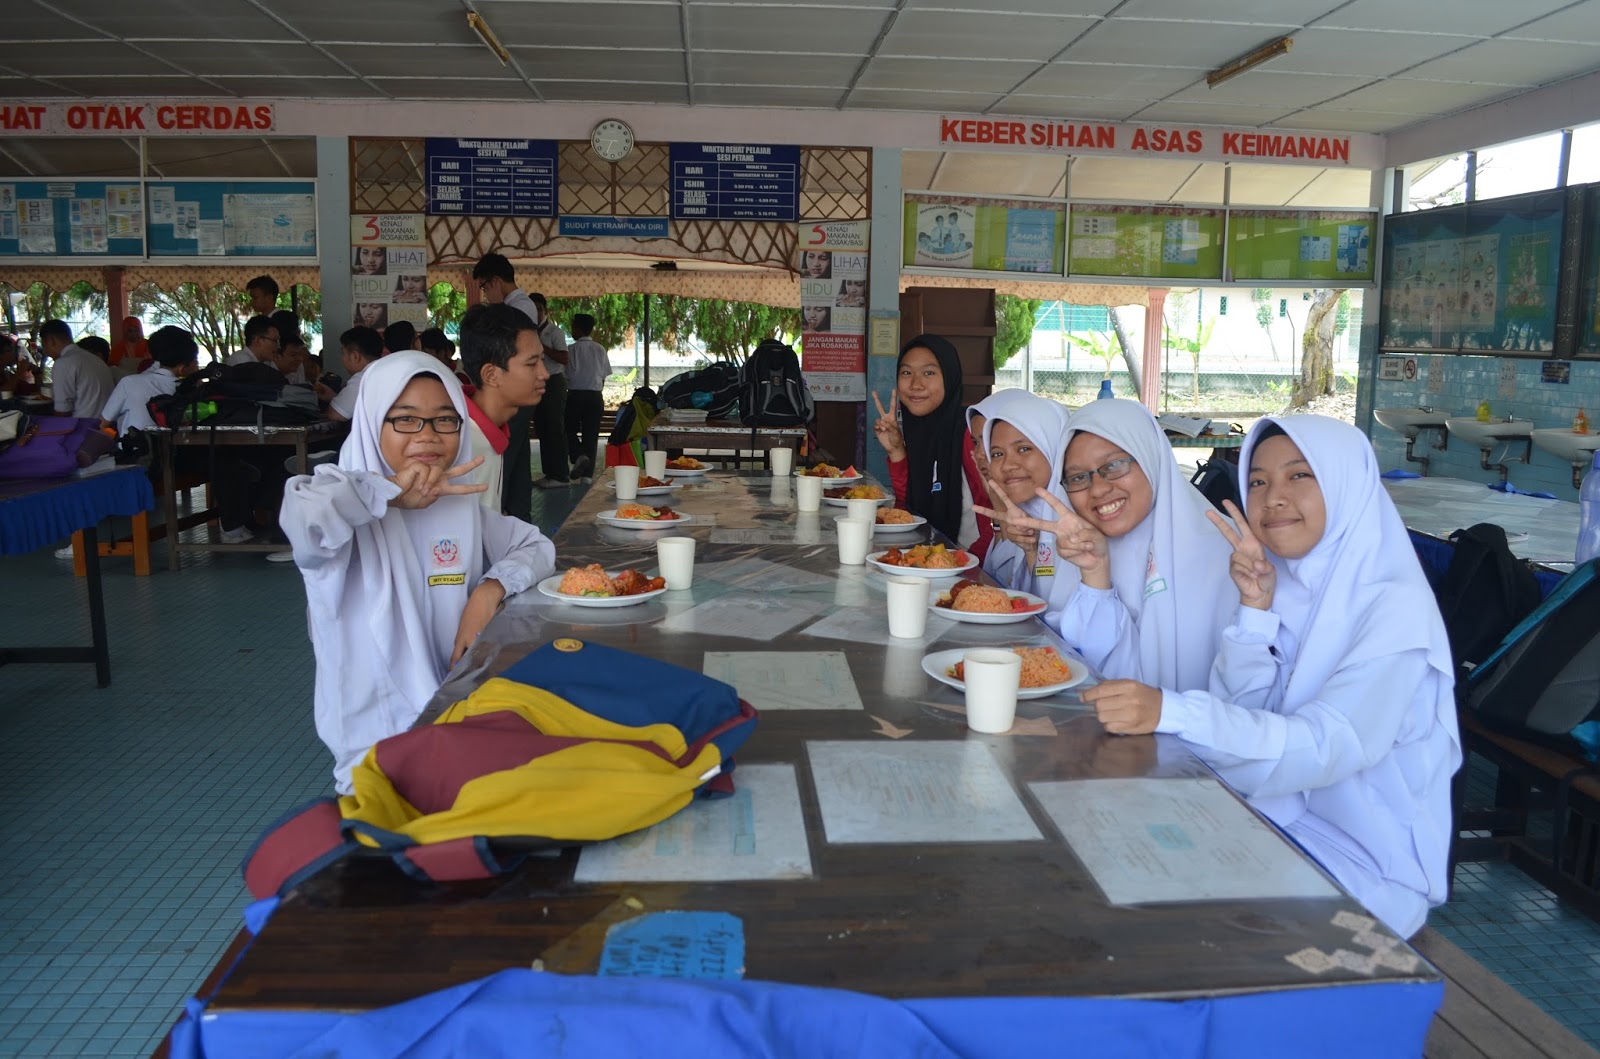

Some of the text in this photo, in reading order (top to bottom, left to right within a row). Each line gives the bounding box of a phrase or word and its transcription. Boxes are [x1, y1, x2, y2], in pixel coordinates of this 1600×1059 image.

[67, 106, 145, 129] OTAK
[157, 106, 271, 129] CERDAS
[458, 141, 529, 149] WAKTU REHAT PELAJAR
[940, 120, 1350, 161] KEBERSIHAN ASAS KEIMANAN
[702, 145, 724, 153] WAKTU
[726, 146, 744, 154] REHAT
[732, 154, 755, 162] PETANG
[441, 162, 460, 170] HARI
[684, 180, 705, 188] ISNIN
[683, 197, 708, 205] KHAMIS
[683, 207, 707, 215] JUMAAT
[592, 222, 646, 230] KETRAMPILAN
[388, 252, 425, 264] LIHAT
[833, 256, 867, 268] LIHAT
[354, 280, 389, 292] HIDU
[801, 283, 833, 296] HIDU
[390, 309, 426, 320] RASA
[832, 313, 865, 324] RASA
